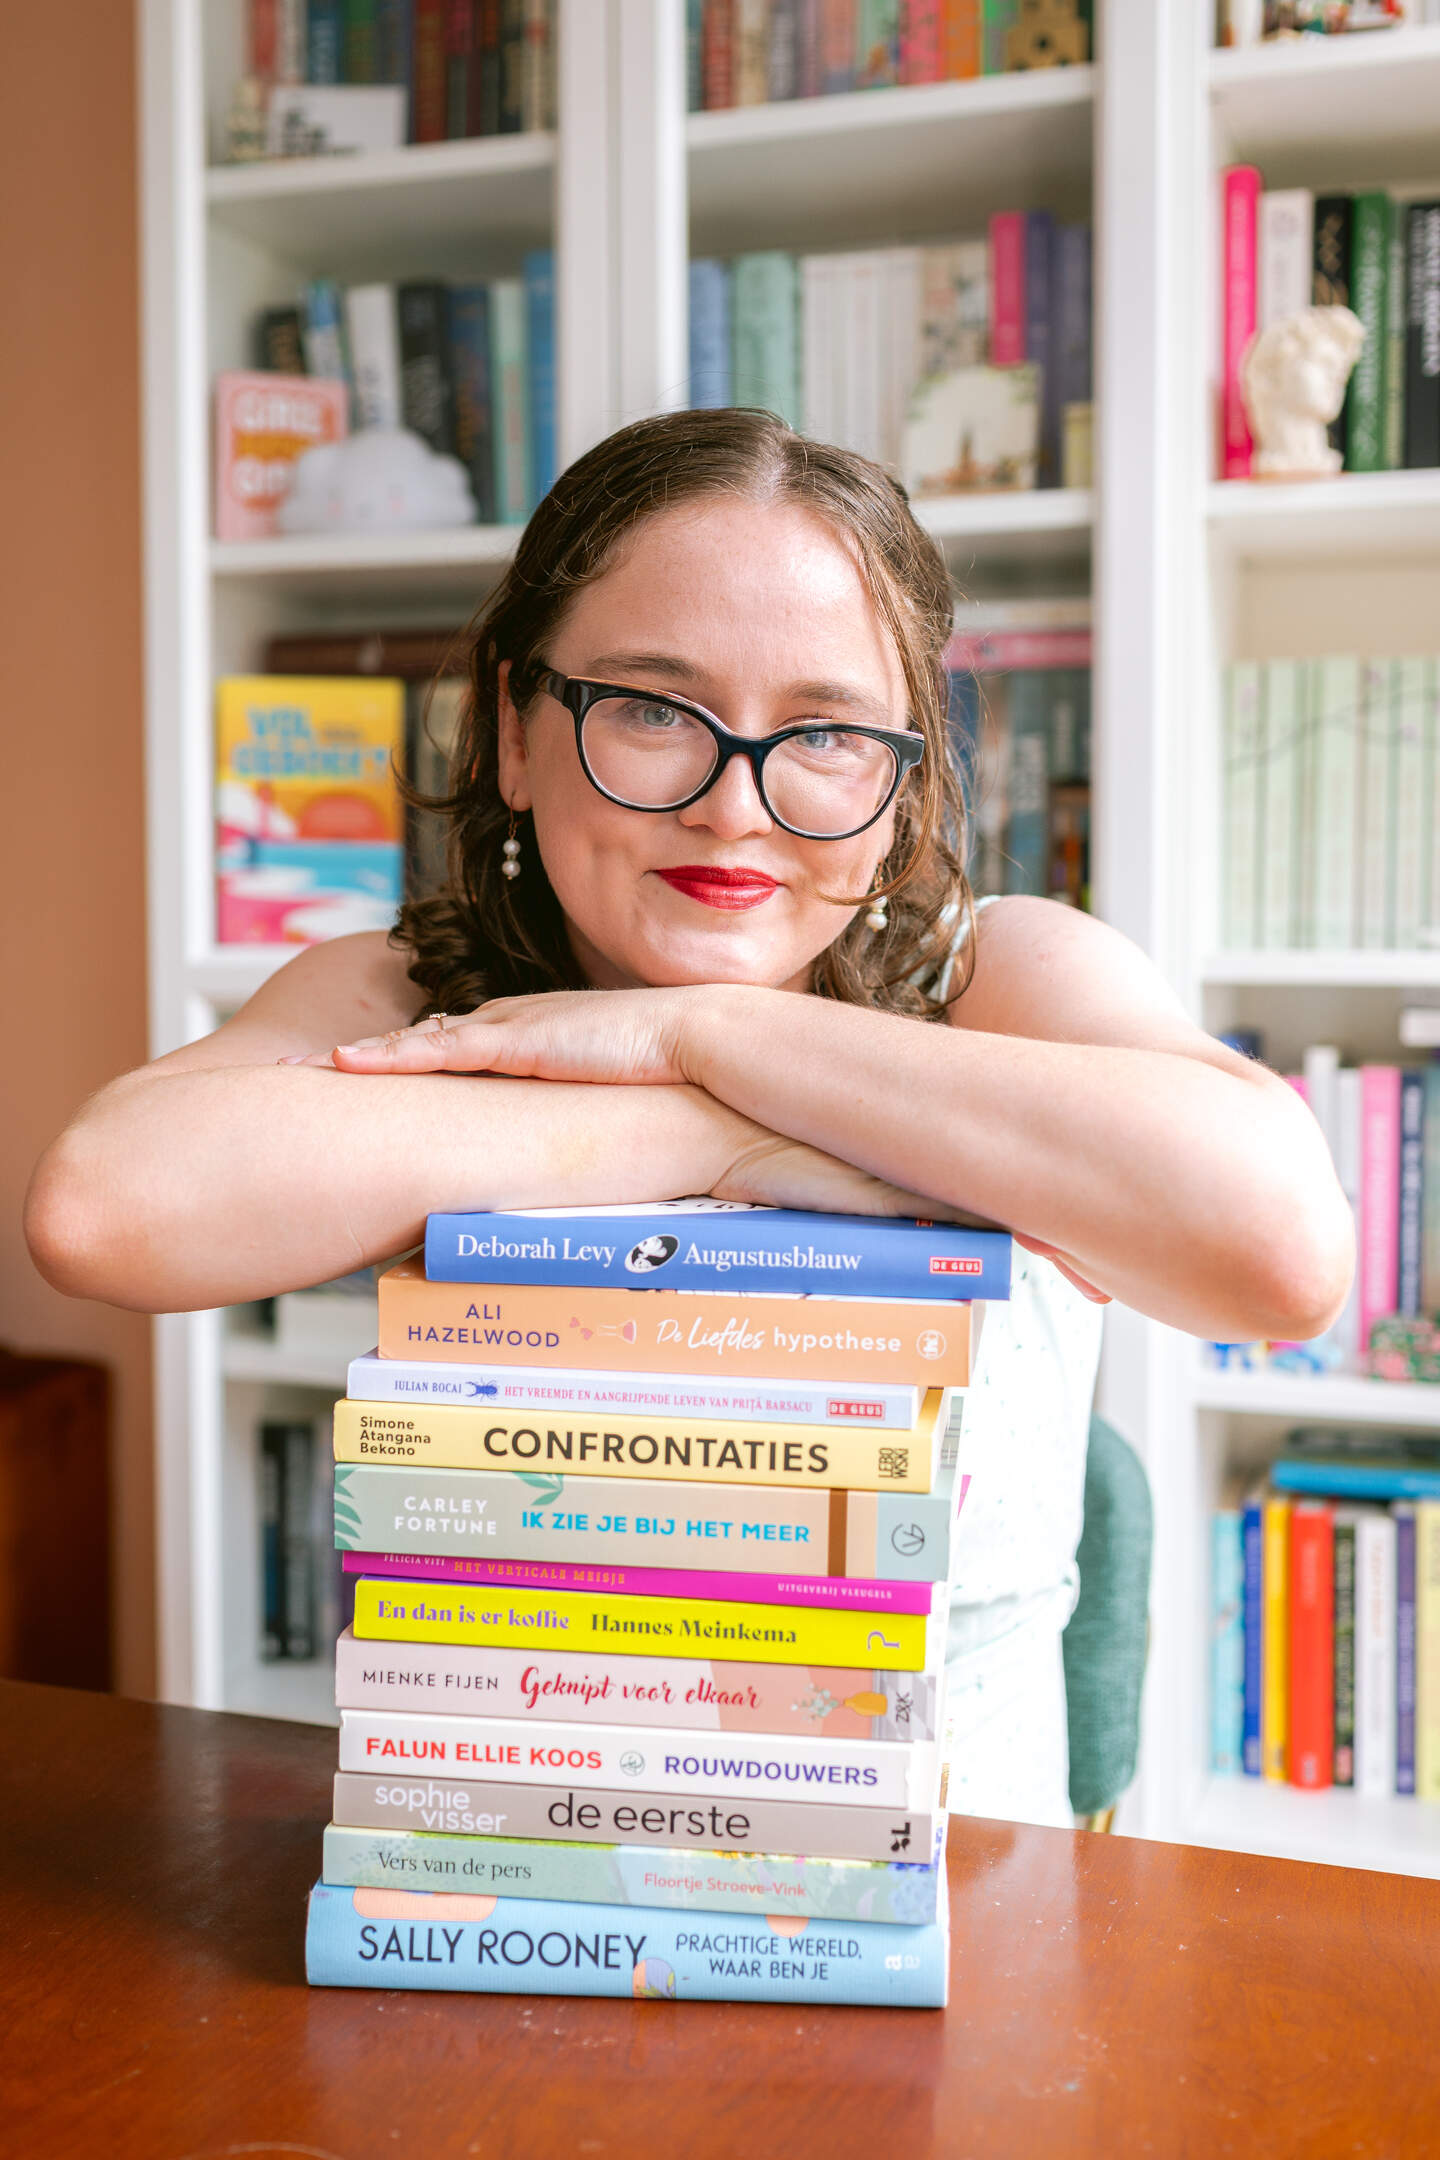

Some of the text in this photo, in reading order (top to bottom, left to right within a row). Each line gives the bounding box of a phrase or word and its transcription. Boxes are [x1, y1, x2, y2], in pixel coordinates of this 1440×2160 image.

[456, 1233, 617, 1268] Deborah Levy
[681, 1242, 863, 1272] Augustusblauw
[932, 1260, 980, 1272] DE GEUS
[465, 1303, 502, 1320] ALI
[406, 1325, 561, 1348] HAZELWOOD
[656, 1316, 902, 1356] De Liefdes hypothese
[504, 1385, 524, 1398] HET
[526, 1386, 575, 1400] VREEMDE
[577, 1389, 591, 1401] EN
[593, 1390, 671, 1406] AANGRIJPENDE
[673, 1394, 707, 1408] LEVEN
[708, 1395, 730, 1409] VAN
[829, 1401, 883, 1417] DE GEUS
[359, 1415, 415, 1431] Simone
[359, 1429, 432, 1446] Atangana
[359, 1442, 416, 1457] Bekono
[483, 1427, 830, 1474] CONFRONTATIES
[403, 1496, 489, 1515] CARLEY
[394, 1515, 498, 1536] FORTUNE
[521, 1511, 811, 1543] IK ZIE JE BIJ HET MEER
[453, 1561, 626, 1586] HET VERTICALE MEISJE
[777, 1582, 893, 1599] UITGEVERIJ VLEUGELS
[376, 1600, 570, 1630] En dan is er koffie
[591, 1613, 798, 1644] Hannes Meinkema
[362, 1670, 500, 1691] MIENKE FIJEN
[519, 1665, 762, 1710] Geknipt voor elkaar
[365, 1736, 603, 1770] FALUN ELLIE KOOS
[663, 1754, 879, 1787] ROUWDOUWERS
[374, 1782, 472, 1812] sophie
[419, 1808, 508, 1833] visser
[547, 1792, 752, 1840] de eerste
[377, 1851, 533, 1882] Vers van de pers
[643, 1871, 807, 1898] Floortje Stroeve-Vink
[357, 1924, 648, 1970] SALLY ROONEY
[675, 1932, 863, 1960] PRACHTIGE WERELD,
[708, 1958, 830, 1981] WAAR BEN JE
